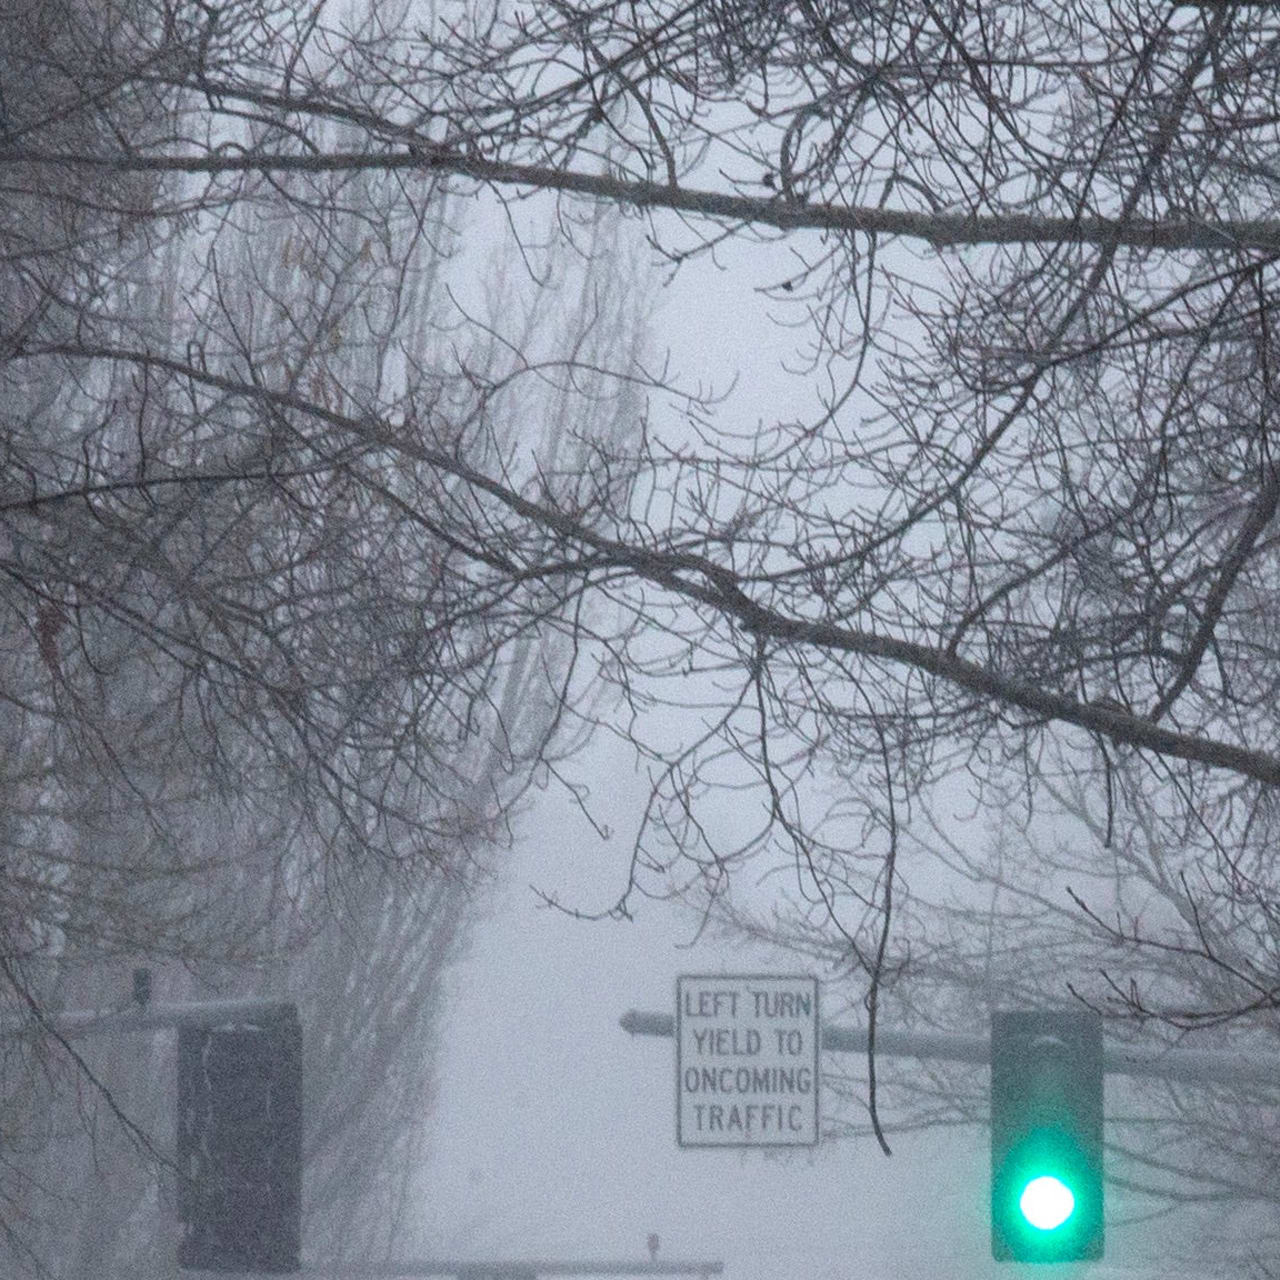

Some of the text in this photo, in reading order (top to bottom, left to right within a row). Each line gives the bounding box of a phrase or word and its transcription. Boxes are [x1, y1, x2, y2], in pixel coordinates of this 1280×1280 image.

[685, 991, 811, 1018] LEFT TURN
[693, 1028, 803, 1056] YIELD TO
[684, 1067, 811, 1094] ONCOMING
[693, 1105, 803, 1131] TRAFFIC
